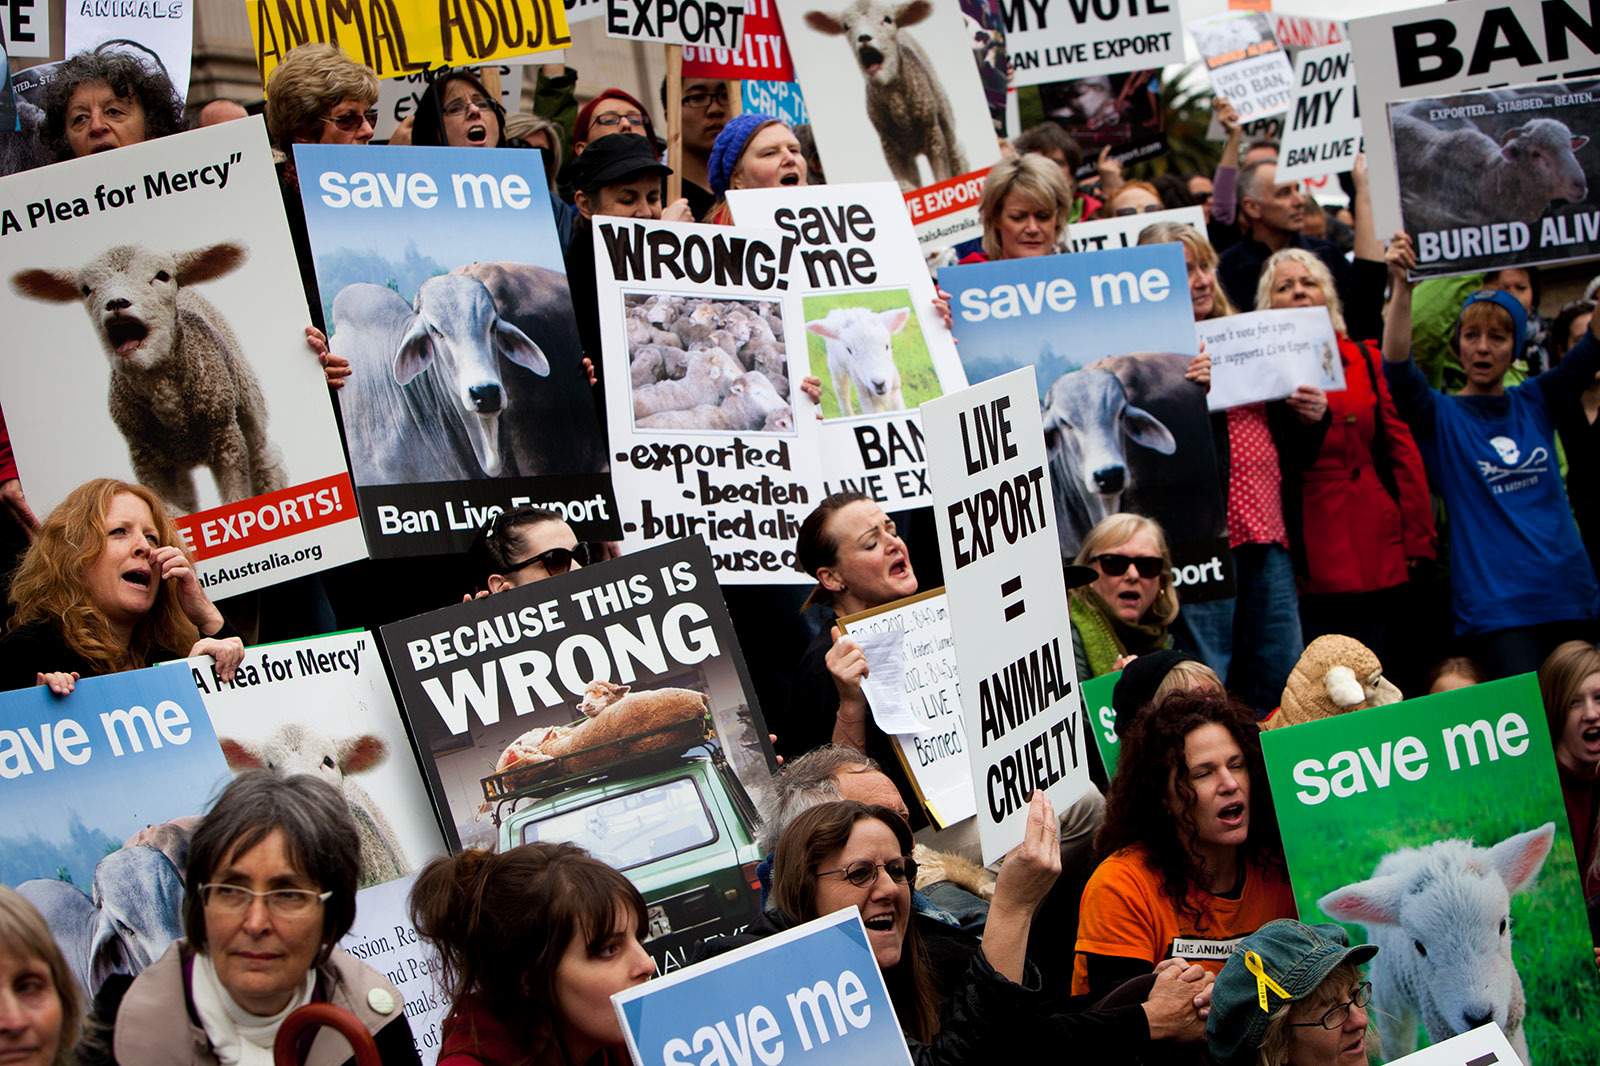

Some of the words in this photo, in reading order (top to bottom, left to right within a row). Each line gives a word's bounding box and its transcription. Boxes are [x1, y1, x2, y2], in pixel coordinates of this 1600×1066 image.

[80, 0, 183, 19] ANIMALS
[607, 0, 745, 49] EXPORT
[1007, 50, 1040, 71] AN
[1045, 43, 1088, 67] LIVE
[1093, 32, 1172, 61] EXPORT
[1392, 0, 1600, 89] BAN
[1292, 87, 1343, 131] MY
[1286, 144, 1319, 168] BAN
[1321, 136, 1355, 160] LIVE
[1, 210, 22, 236] A
[28, 197, 90, 229] Plea
[94, 182, 136, 212] for
[319, 171, 439, 209] save
[451, 172, 532, 210] me
[774, 203, 876, 246] save
[1417, 220, 1531, 263] BURIED
[1539, 211, 1600, 248] ALIV
[600, 222, 799, 291] WRONG!
[800, 246, 878, 288] me
[960, 278, 1077, 322] save
[1090, 268, 1171, 308] me
[958, 395, 1019, 477] LIVE
[201, 486, 343, 548] EXPORTS!
[377, 504, 440, 535] Ban
[511, 494, 610, 523] port
[947, 465, 1047, 570] EXPORT
[407, 600, 565, 672] BECAUSE
[570, 573, 654, 622] THIS
[660, 560, 698, 597] IS
[262, 653, 293, 683] for
[421, 602, 721, 736] WRONG
[978, 637, 1072, 749] ANIMAL
[99, 700, 192, 758] me
[921, 689, 953, 719] LIVE
[913, 722, 962, 767] Banned
[986, 711, 1080, 825] CRUELTY
[1293, 735, 1430, 806] save
[1443, 711, 1531, 771] me
[662, 1004, 785, 1066] save
[785, 969, 872, 1052] me
